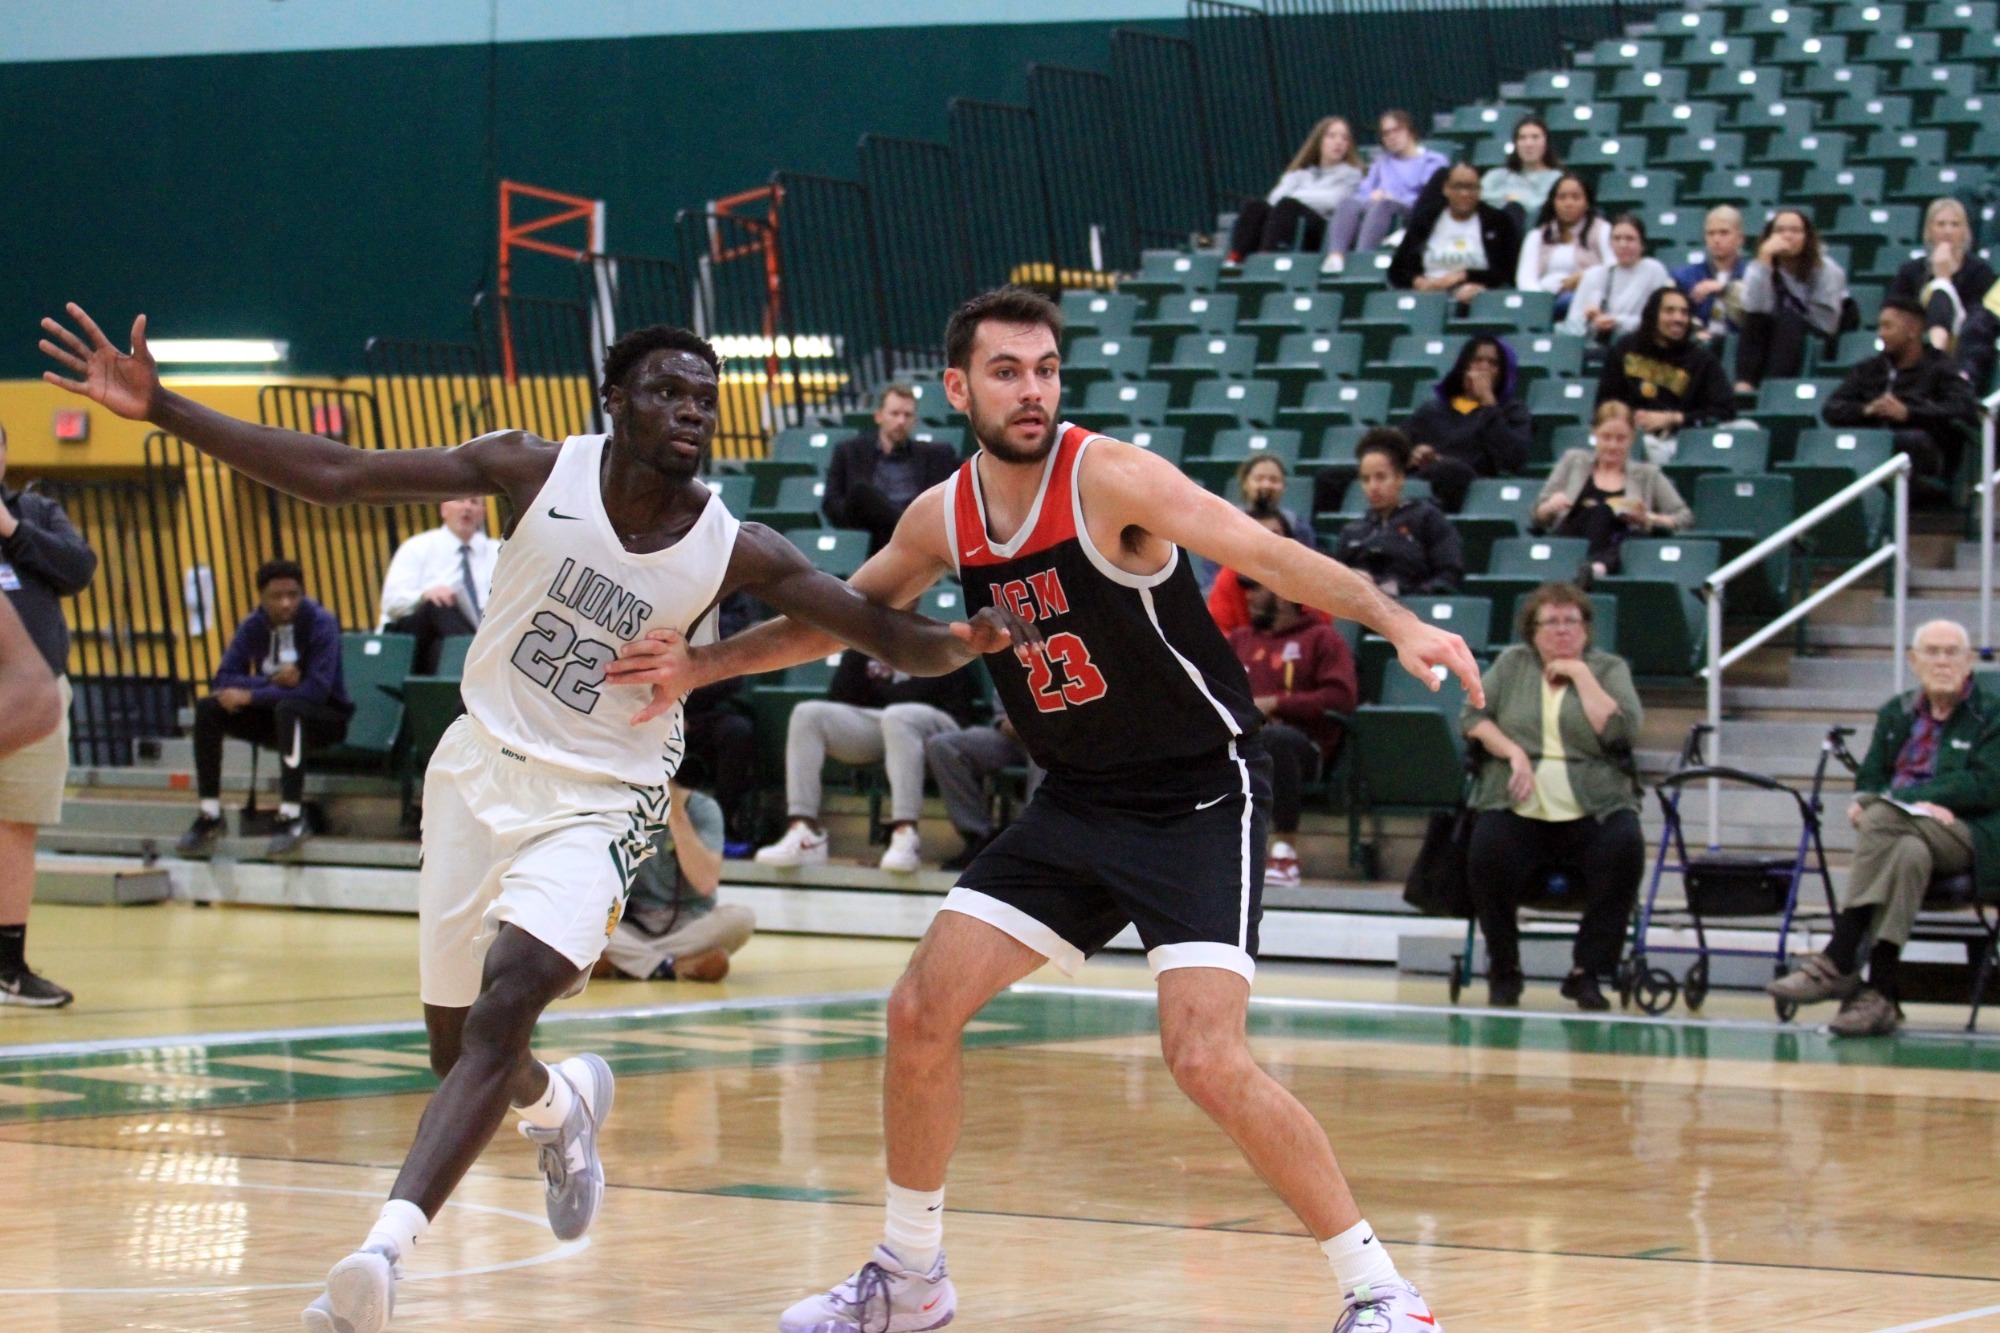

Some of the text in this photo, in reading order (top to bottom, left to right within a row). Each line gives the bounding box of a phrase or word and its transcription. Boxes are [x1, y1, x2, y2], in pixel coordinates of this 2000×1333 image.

[547, 557, 653, 641] LIONS
[511, 610, 619, 715] 22
[1013, 631, 1108, 713] 23
